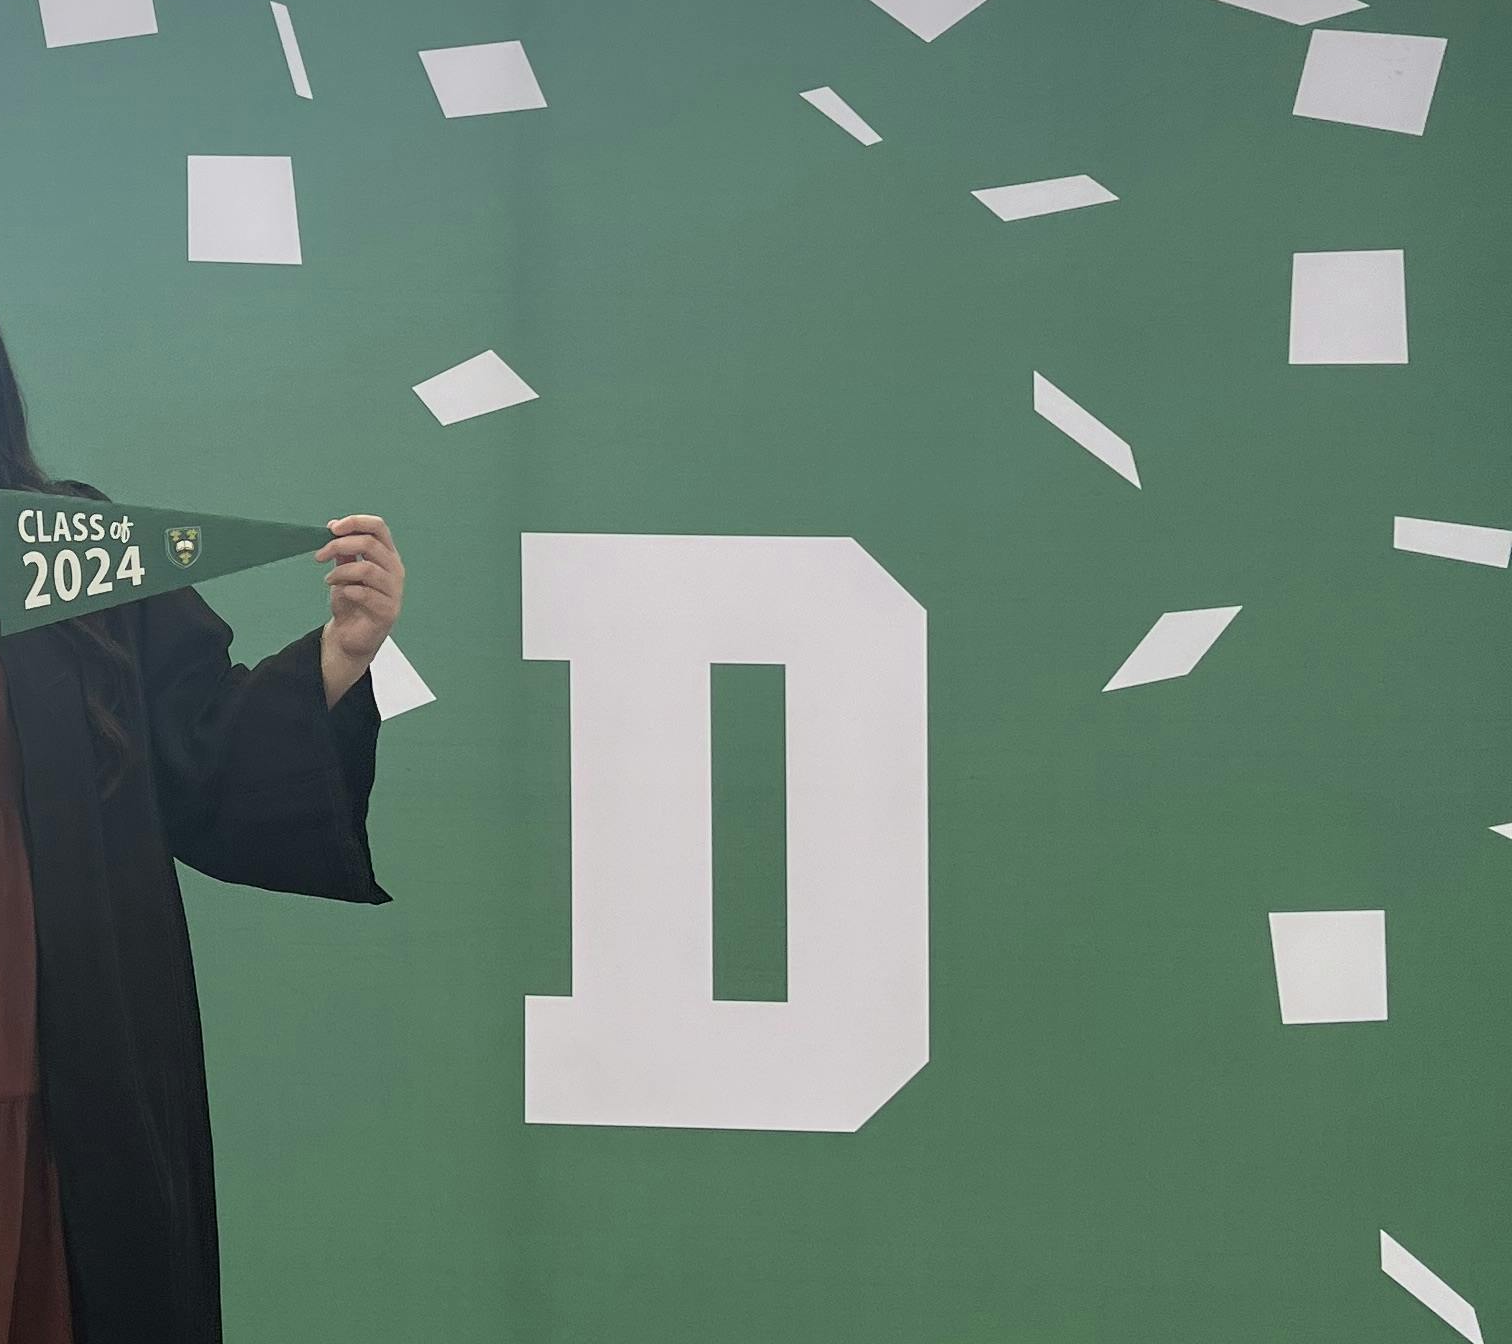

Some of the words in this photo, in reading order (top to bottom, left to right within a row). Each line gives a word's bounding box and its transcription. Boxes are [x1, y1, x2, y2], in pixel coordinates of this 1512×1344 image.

[17, 509, 106, 543] CLASS
[109, 515, 135, 544] of
[22, 545, 146, 610] 2024
[521, 532, 930, 1133] D
